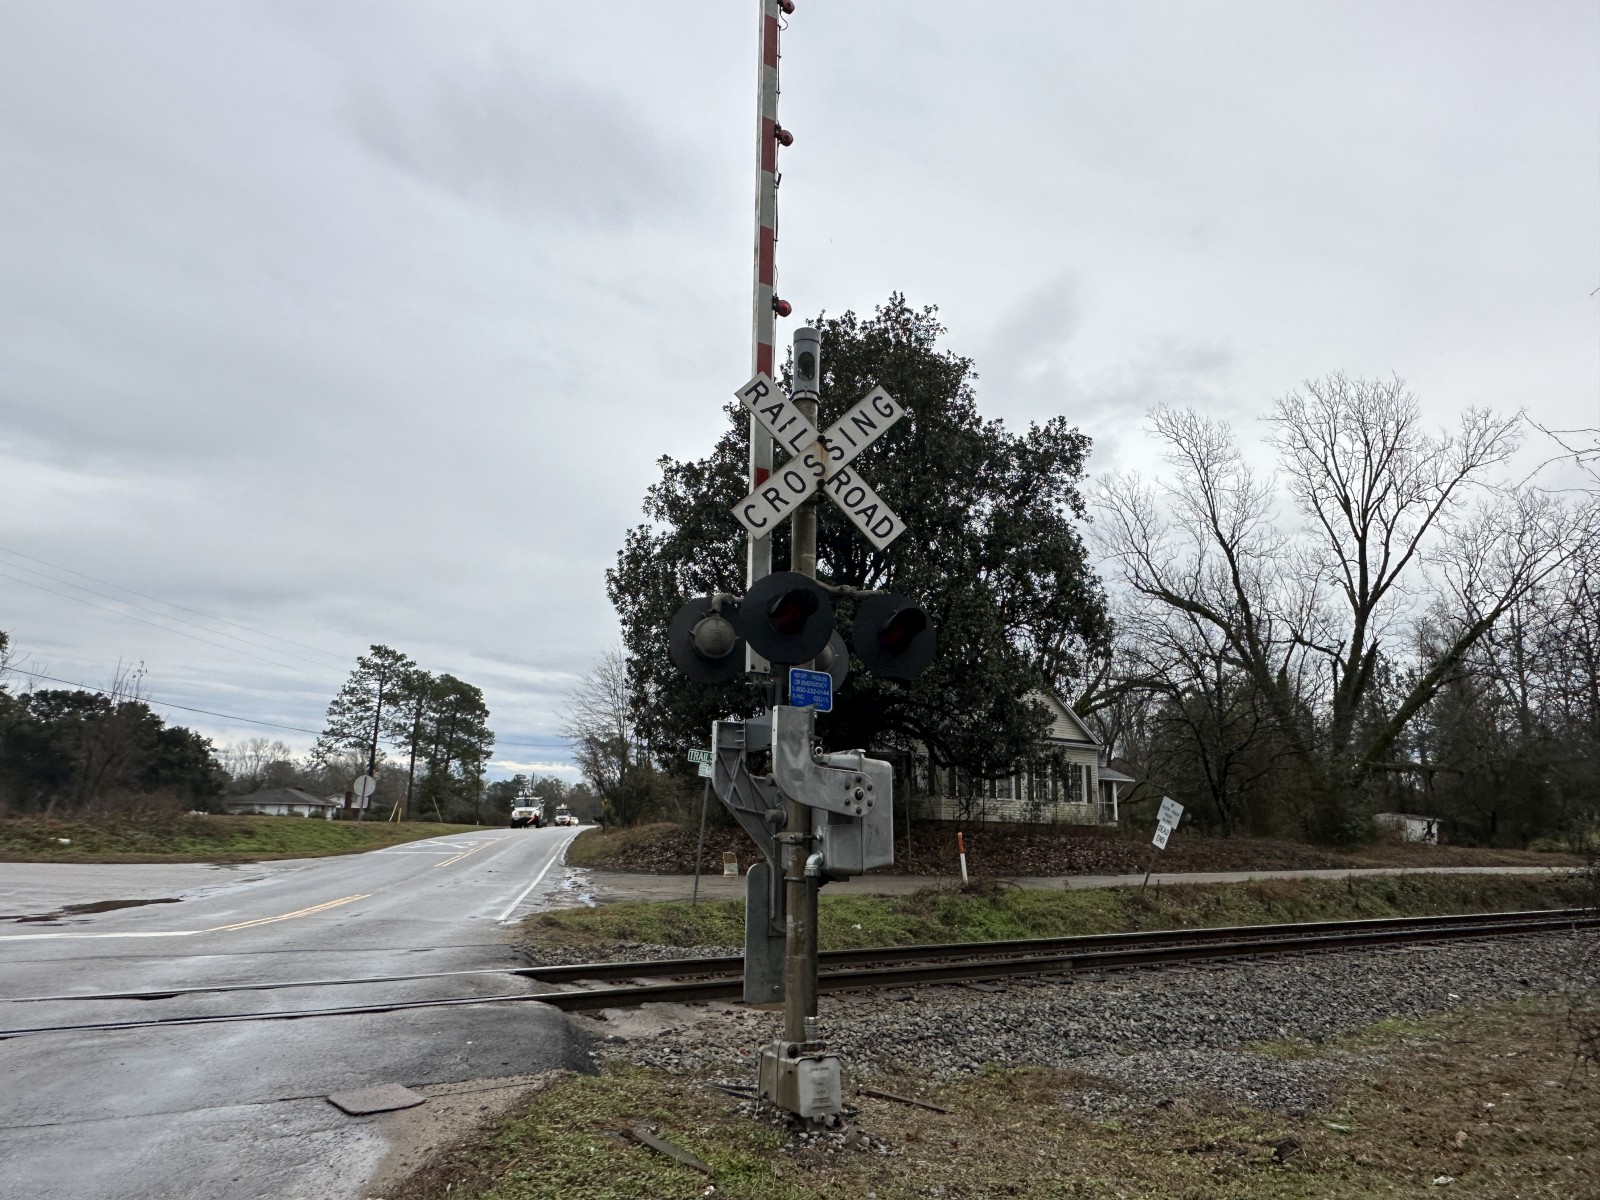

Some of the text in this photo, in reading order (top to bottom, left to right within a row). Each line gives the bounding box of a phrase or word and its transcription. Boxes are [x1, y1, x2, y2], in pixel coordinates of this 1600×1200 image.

[743, 395, 894, 528] CROSSING
[744, 380, 894, 538] RAIL ROAD
[801, 680, 827, 688] EMERGENCY
